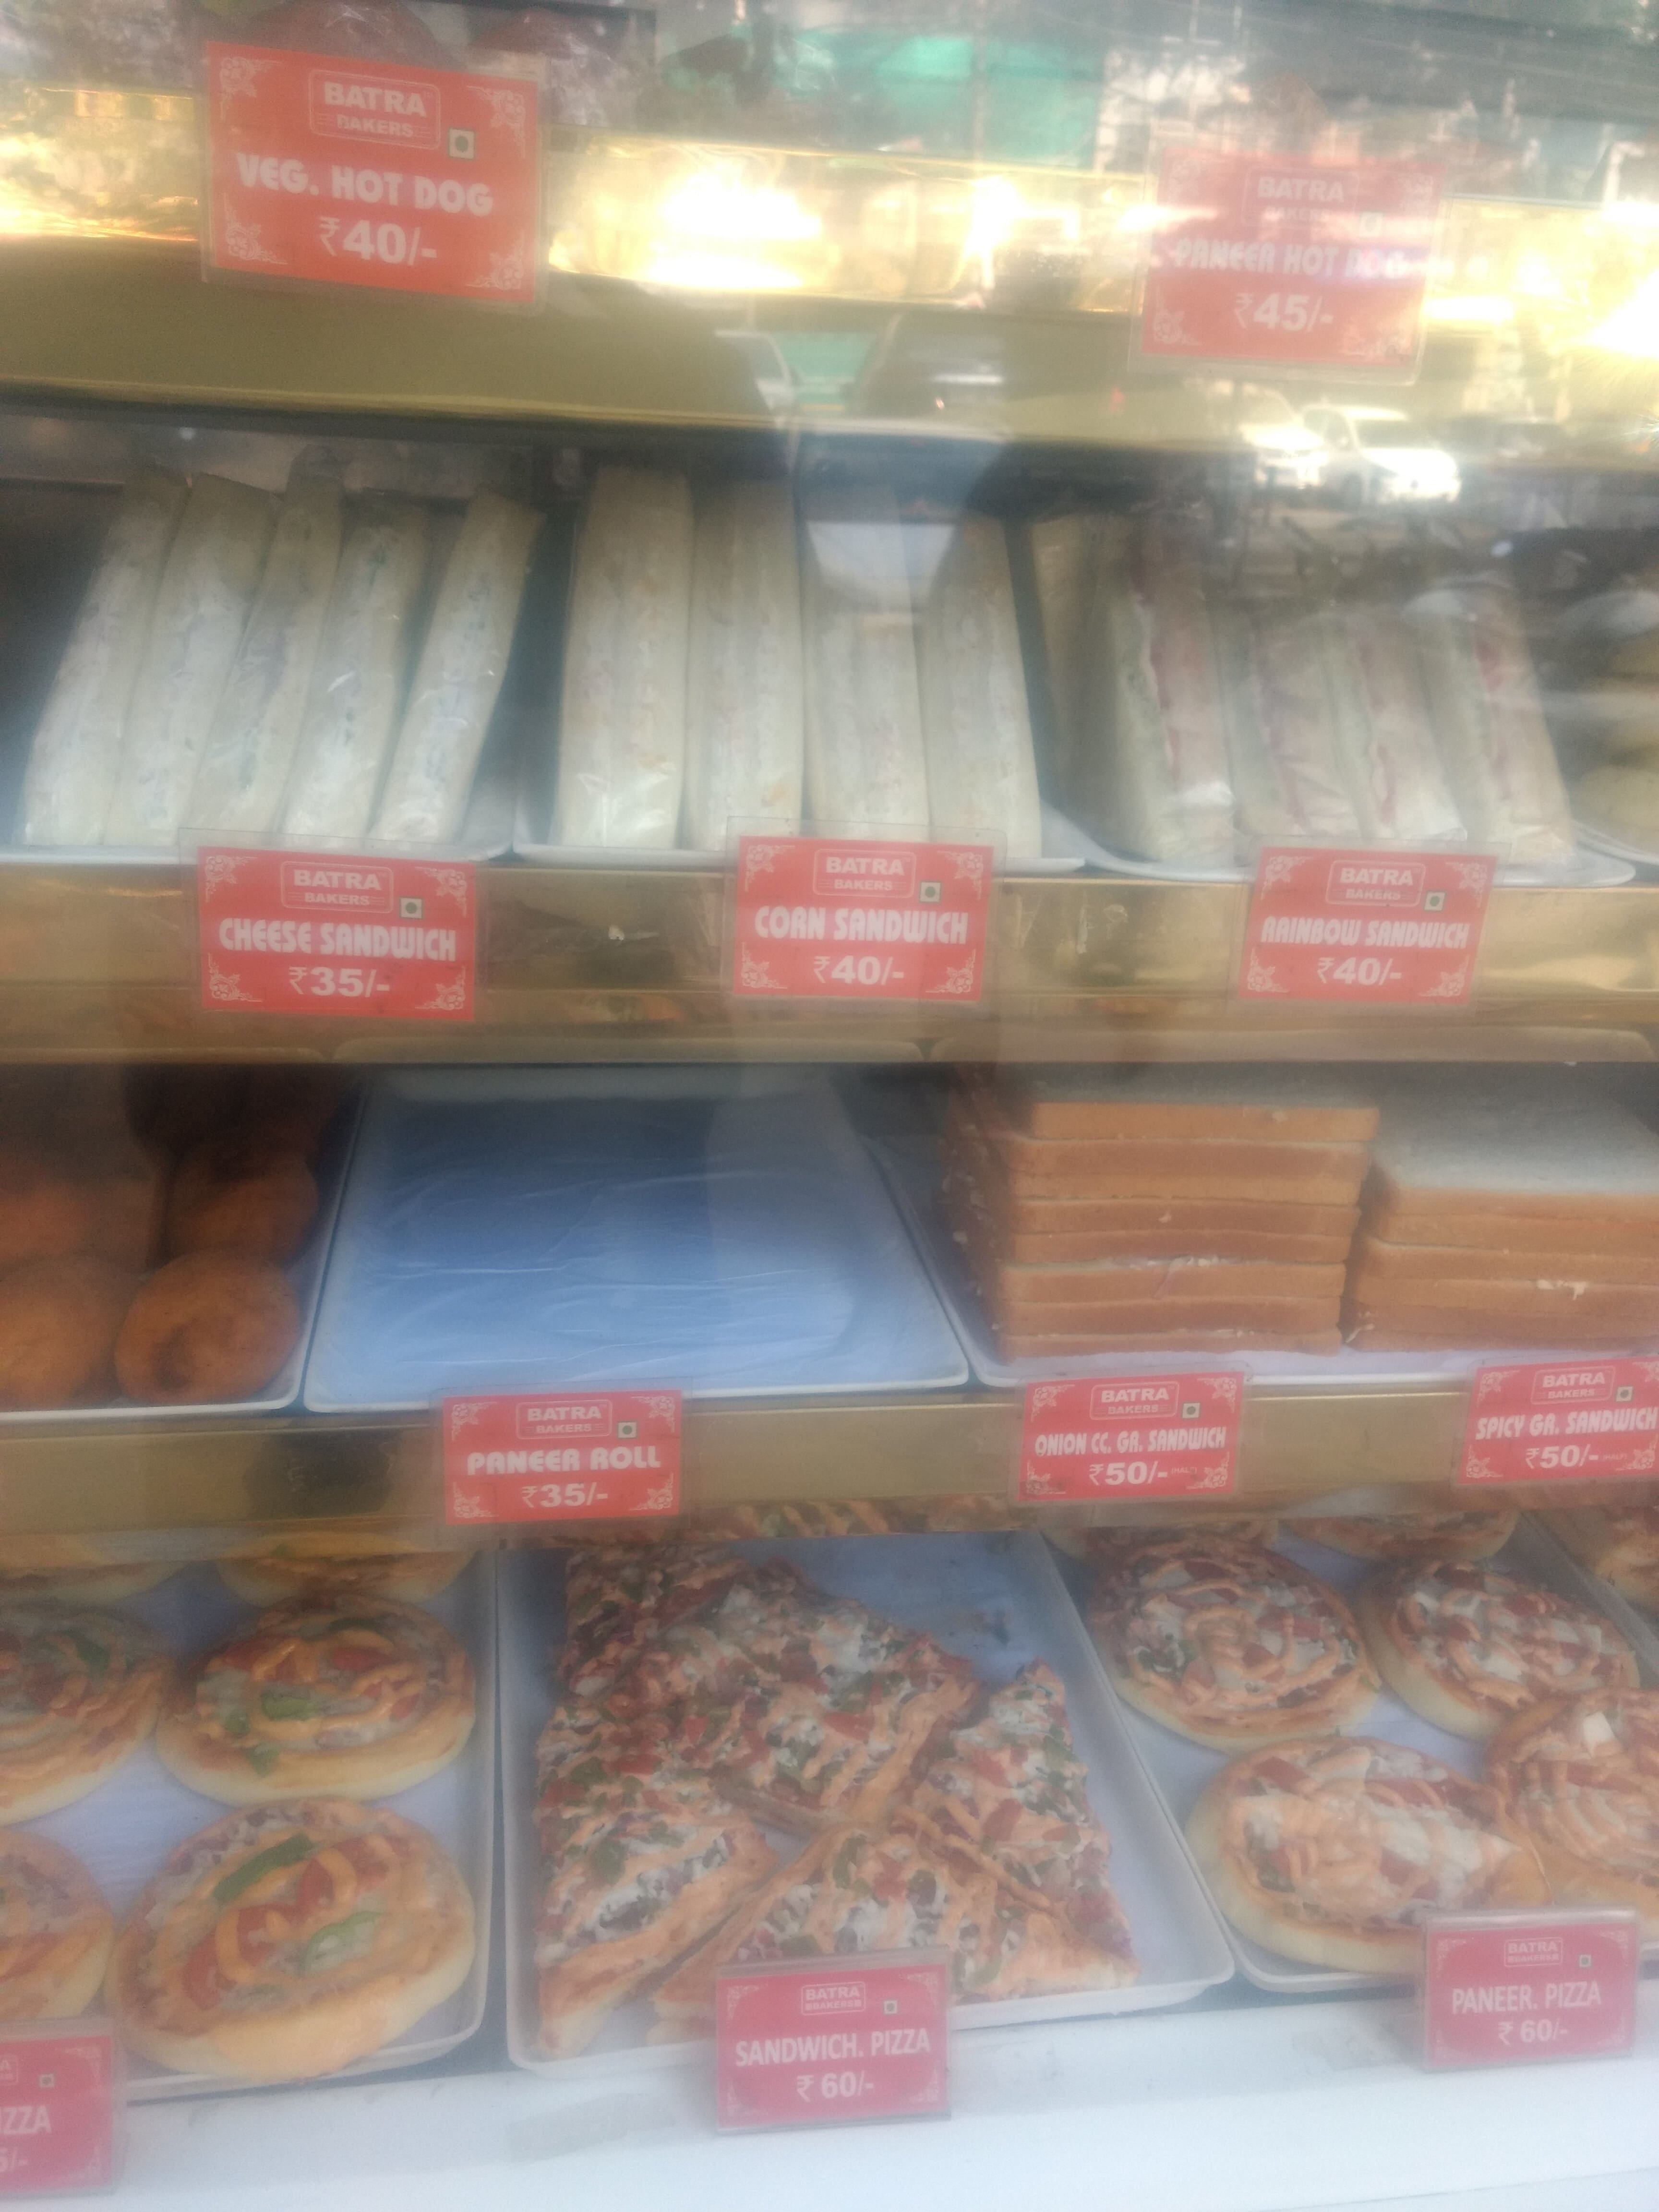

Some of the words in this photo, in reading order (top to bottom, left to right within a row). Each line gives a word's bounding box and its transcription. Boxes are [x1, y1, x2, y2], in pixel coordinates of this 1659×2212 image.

[324, 81, 427, 118] BATRA
[337, 114, 415, 138] BAKERS
[237, 153, 319, 196] VEG.
[331, 165, 403, 206] HOT
[414, 175, 493, 217] DOG
[1258, 176, 1345, 203] BATRA
[319, 216, 437, 266] ₹40/-
[1174, 238, 1275, 274] PANEER
[1282, 243, 1340, 277] HOT
[1234, 291, 1334, 333] ₹45/-
[294, 869, 382, 890] BATRA
[826, 857, 905, 876] BATRA
[1340, 867, 1414, 886] BATRA
[834, 879, 893, 891] BAKERS
[1346, 890, 1401, 901] BAKERS
[305, 892, 370, 906] BAKERS
[755, 906, 826, 940] CORN
[833, 908, 969, 945] SANDWICH
[1261, 916, 1362, 946] RAINBOW
[1365, 920, 1471, 949] SANDWICH
[219, 917, 312, 954] CHEESE
[321, 923, 456, 962] SANDWICH
[289, 966, 390, 998] ₹35/-
[814, 955, 904, 986] ₹40/-
[1317, 957, 1403, 986] ₹40/-
[1542, 1372, 1606, 1388] BATRA
[1101, 1387, 1169, 1403] BATRA
[1548, 1388, 1595, 1399] BAKERS
[528, 1406, 602, 1421] BATRA
[1108, 1404, 1159, 1414] BAKERS
[536, 1424, 592, 1433] BAKERS
[1475, 1415, 1526, 1440] SPICY
[1529, 1413, 1560, 1436] GR.
[1565, 1407, 1659, 1434] SANDWICH
[1035, 1433, 1087, 1456] ONION
[1117, 1431, 1143, 1453] GR.
[1147, 1427, 1226, 1452] SANDWICH
[468, 1448, 580, 1476] PANEER
[590, 1445, 661, 1470] ROLL
[1525, 1444, 1599, 1469] ₹50/-
[1089, 1461, 1168, 1486] ₹50/-
[522, 1482, 609, 1508] ₹35/-
[1508, 1941, 1558, 1954] BATRA
[806, 1986, 860, 2001] BATRA
[813, 2000, 854, 2010] BAKERS
[1452, 1984, 1539, 2015] PANEER.
[1544, 1980, 1602, 2008] PIZZA
[735, 2032, 864, 2067] SANDWICH.
[871, 2028, 931, 2056] PIZZA
[0, 2105, 51, 2134] ZZA
